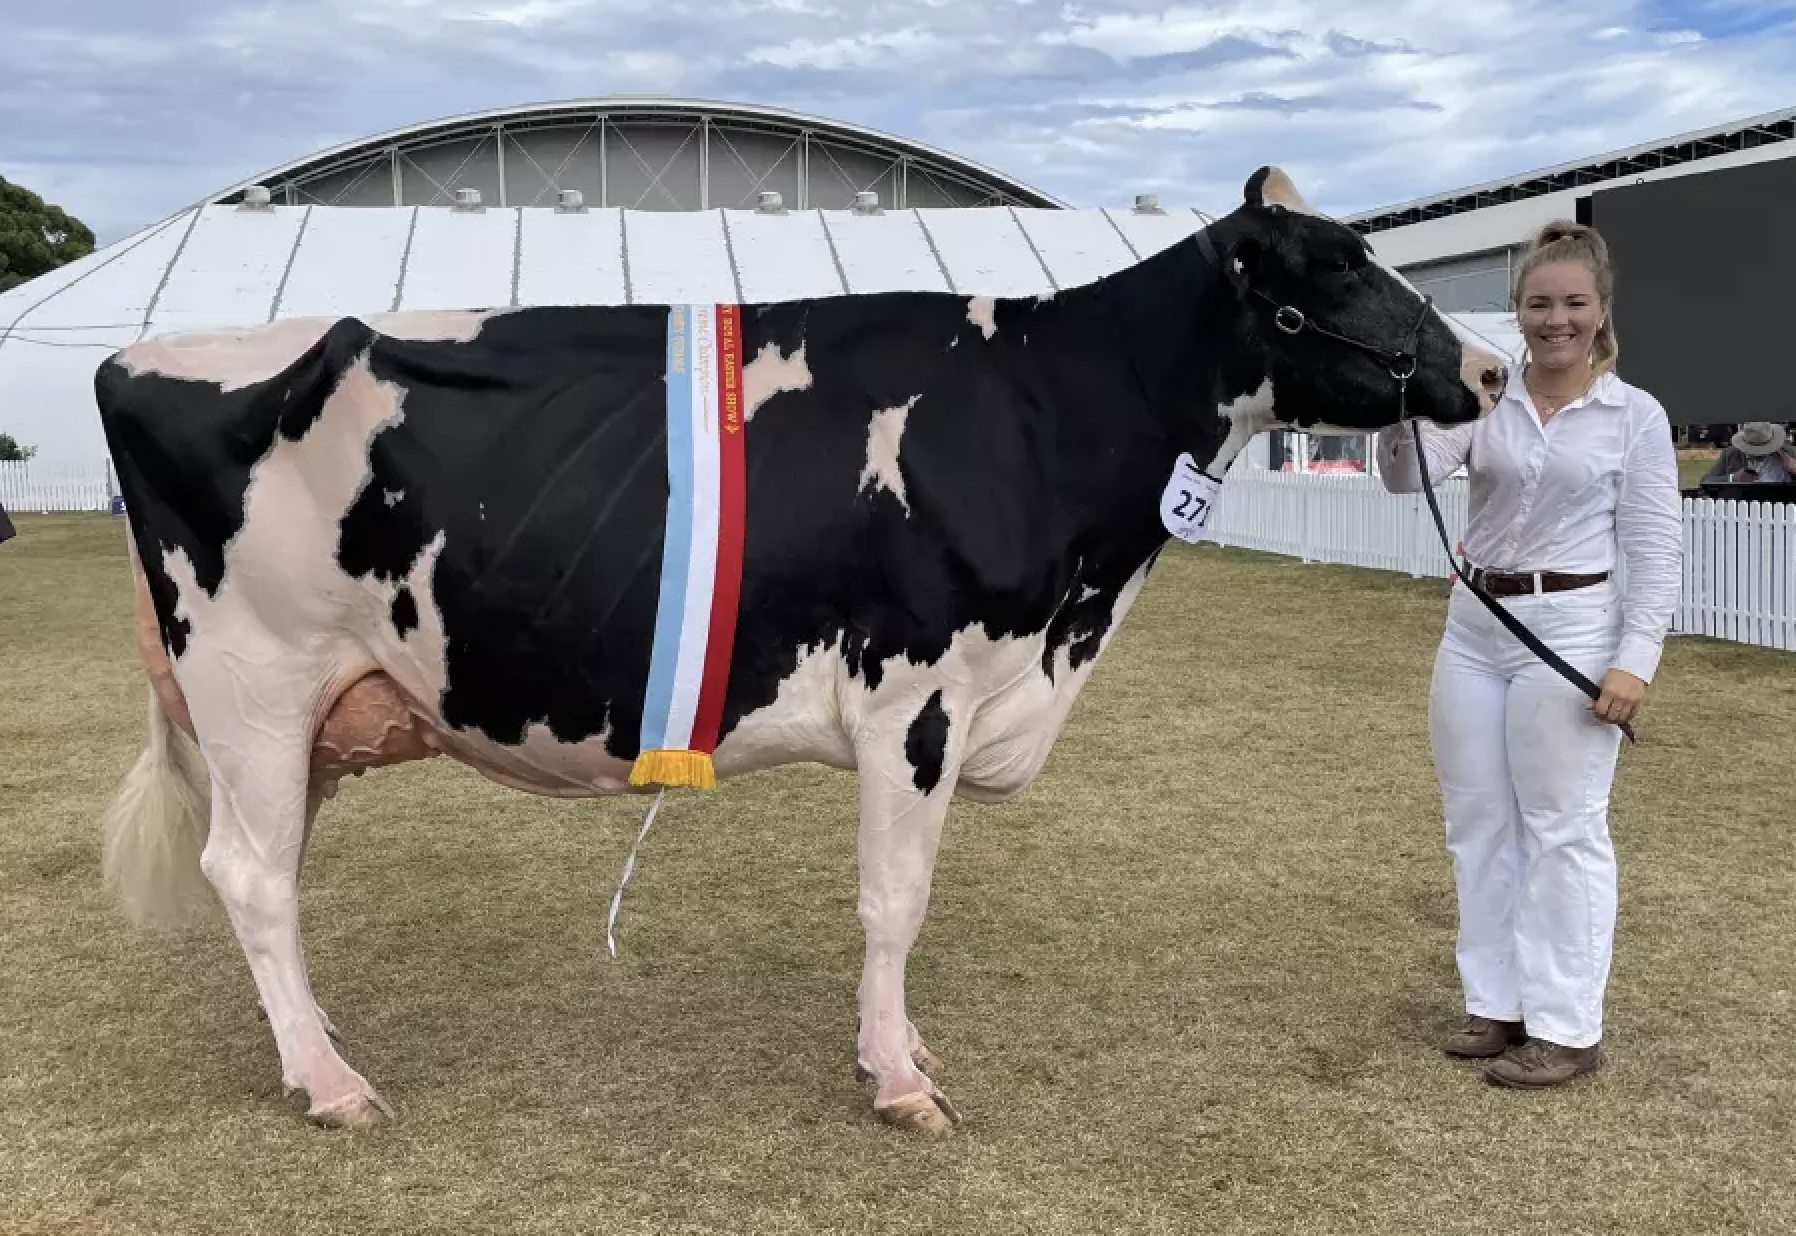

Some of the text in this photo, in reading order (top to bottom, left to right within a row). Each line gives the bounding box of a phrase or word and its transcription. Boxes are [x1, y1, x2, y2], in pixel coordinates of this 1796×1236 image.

[723, 317, 734, 351] ROYAL
[725, 353, 736, 390] EASTER
[726, 392, 738, 423] SHOW
